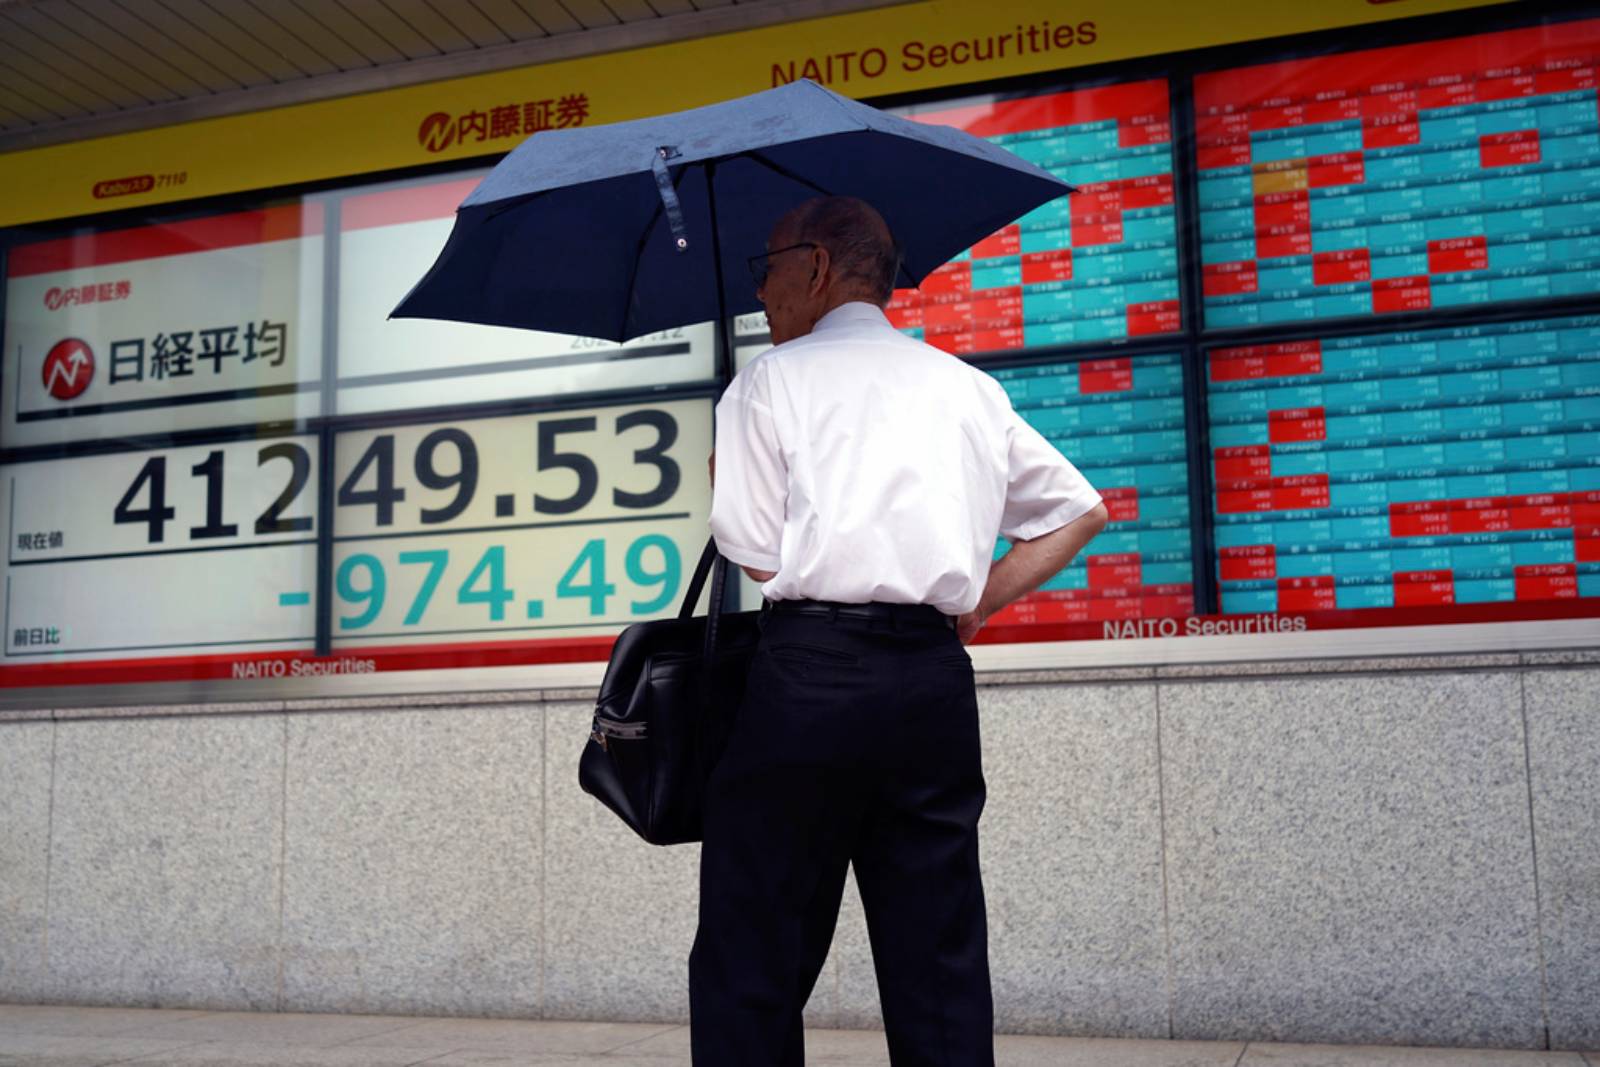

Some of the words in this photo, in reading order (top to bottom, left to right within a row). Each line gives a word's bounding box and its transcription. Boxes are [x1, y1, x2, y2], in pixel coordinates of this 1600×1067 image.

[771, 48, 887, 88] NAITO
[901, 21, 1097, 72] Securities
[458, 93, 590, 145] 内藤証券
[109, 319, 287, 385] 日経平均
[17, 531, 64, 551] 現在値
[13, 627, 61, 647] 前日比
[1103, 617, 1178, 640] NAITO
[1185, 613, 1307, 637] Securities
[231, 659, 287, 679] NAITO
[289, 656, 377, 678] Securities
